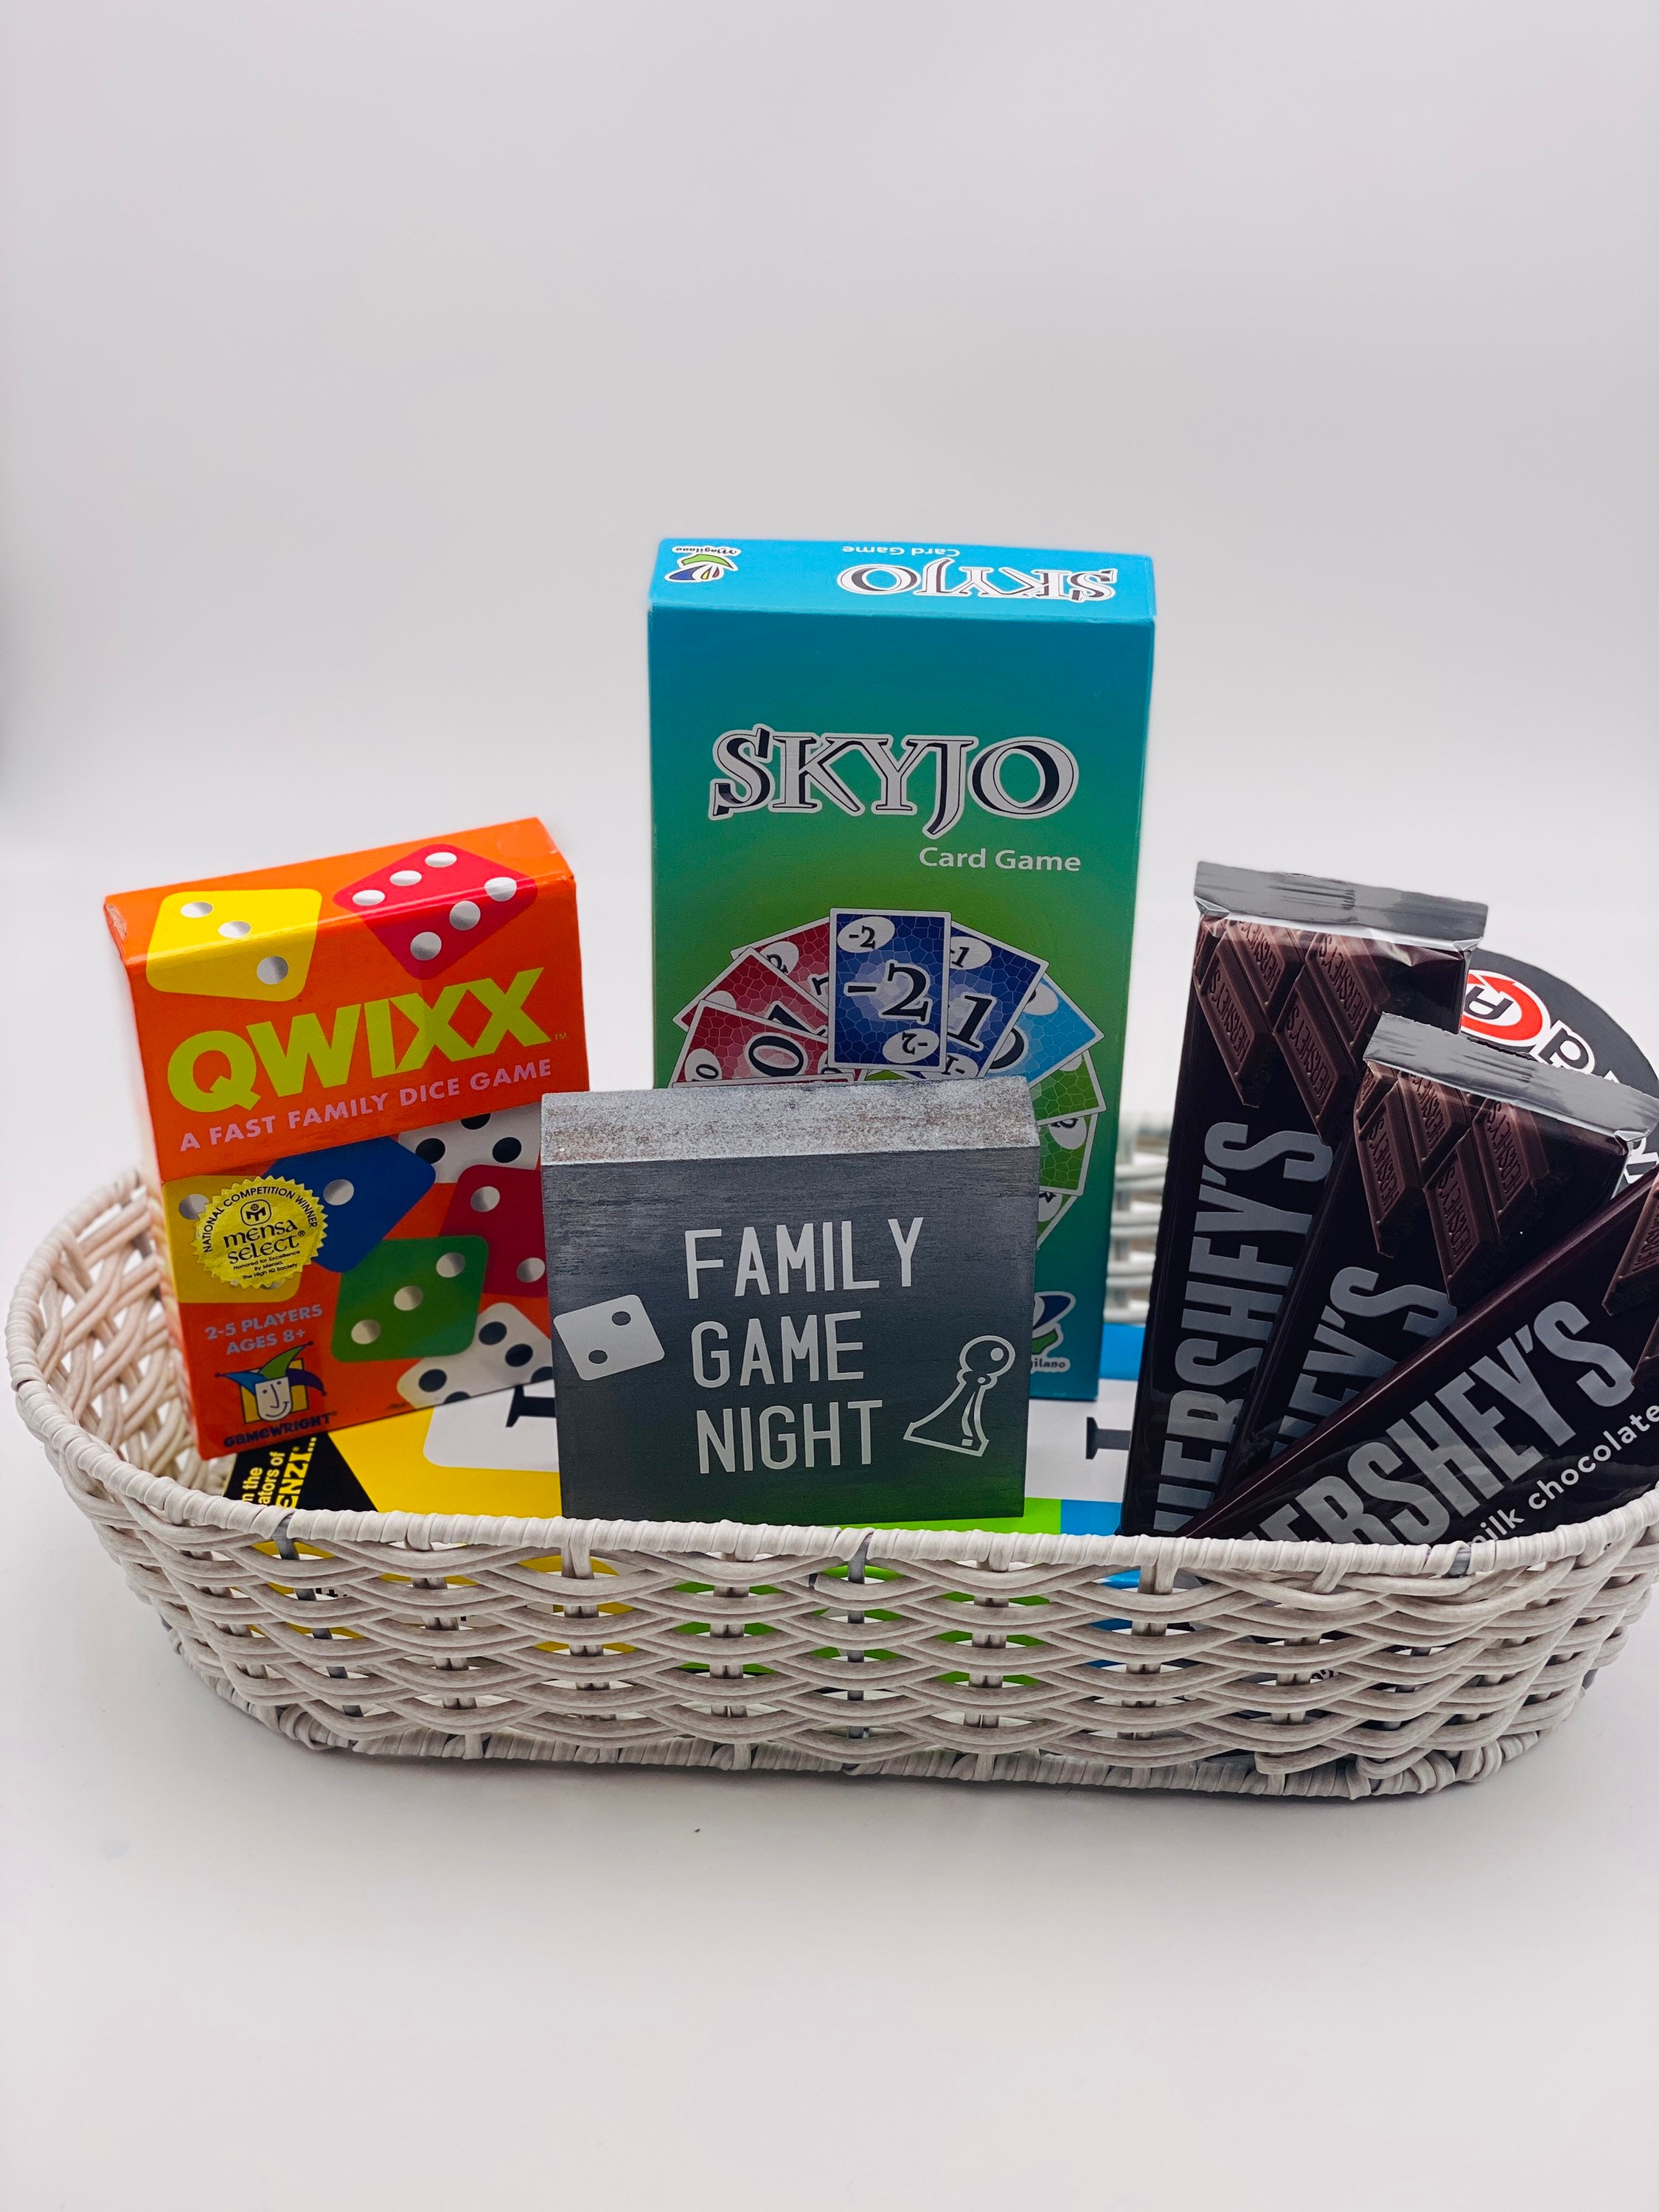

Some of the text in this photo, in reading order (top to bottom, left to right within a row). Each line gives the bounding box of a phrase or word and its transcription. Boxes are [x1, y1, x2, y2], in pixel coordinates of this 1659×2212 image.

[842, 546, 961, 557] Card Game
[836, 557, 1118, 603] SKYJO
[708, 723, 1080, 841] SKYJO
[919, 846, 1082, 872] Card Game
[848, 925, 876, 950] -2
[844, 960, 931, 1023] -2
[167, 967, 552, 1111] QWIXX
[180, 1059, 552, 1152] A FAST FAMILY DICE GAME
[202, 1186, 319, 1253] NATIONAL COMPETITION WINNER
[268, 1250, 301, 1262] Excellence
[684, 1217, 924, 1300] FAMILY
[204, 1304, 323, 1340] 2-5 PLAYERS
[226, 1329, 306, 1355] AGES 8+
[690, 1311, 864, 1388] GAME
[269, 1451, 285, 1467] of
[696, 1399, 883, 1474] NIGHT
[1528, 1405, 1659, 1511] chocolate
[242, 1467, 263, 1490] the
